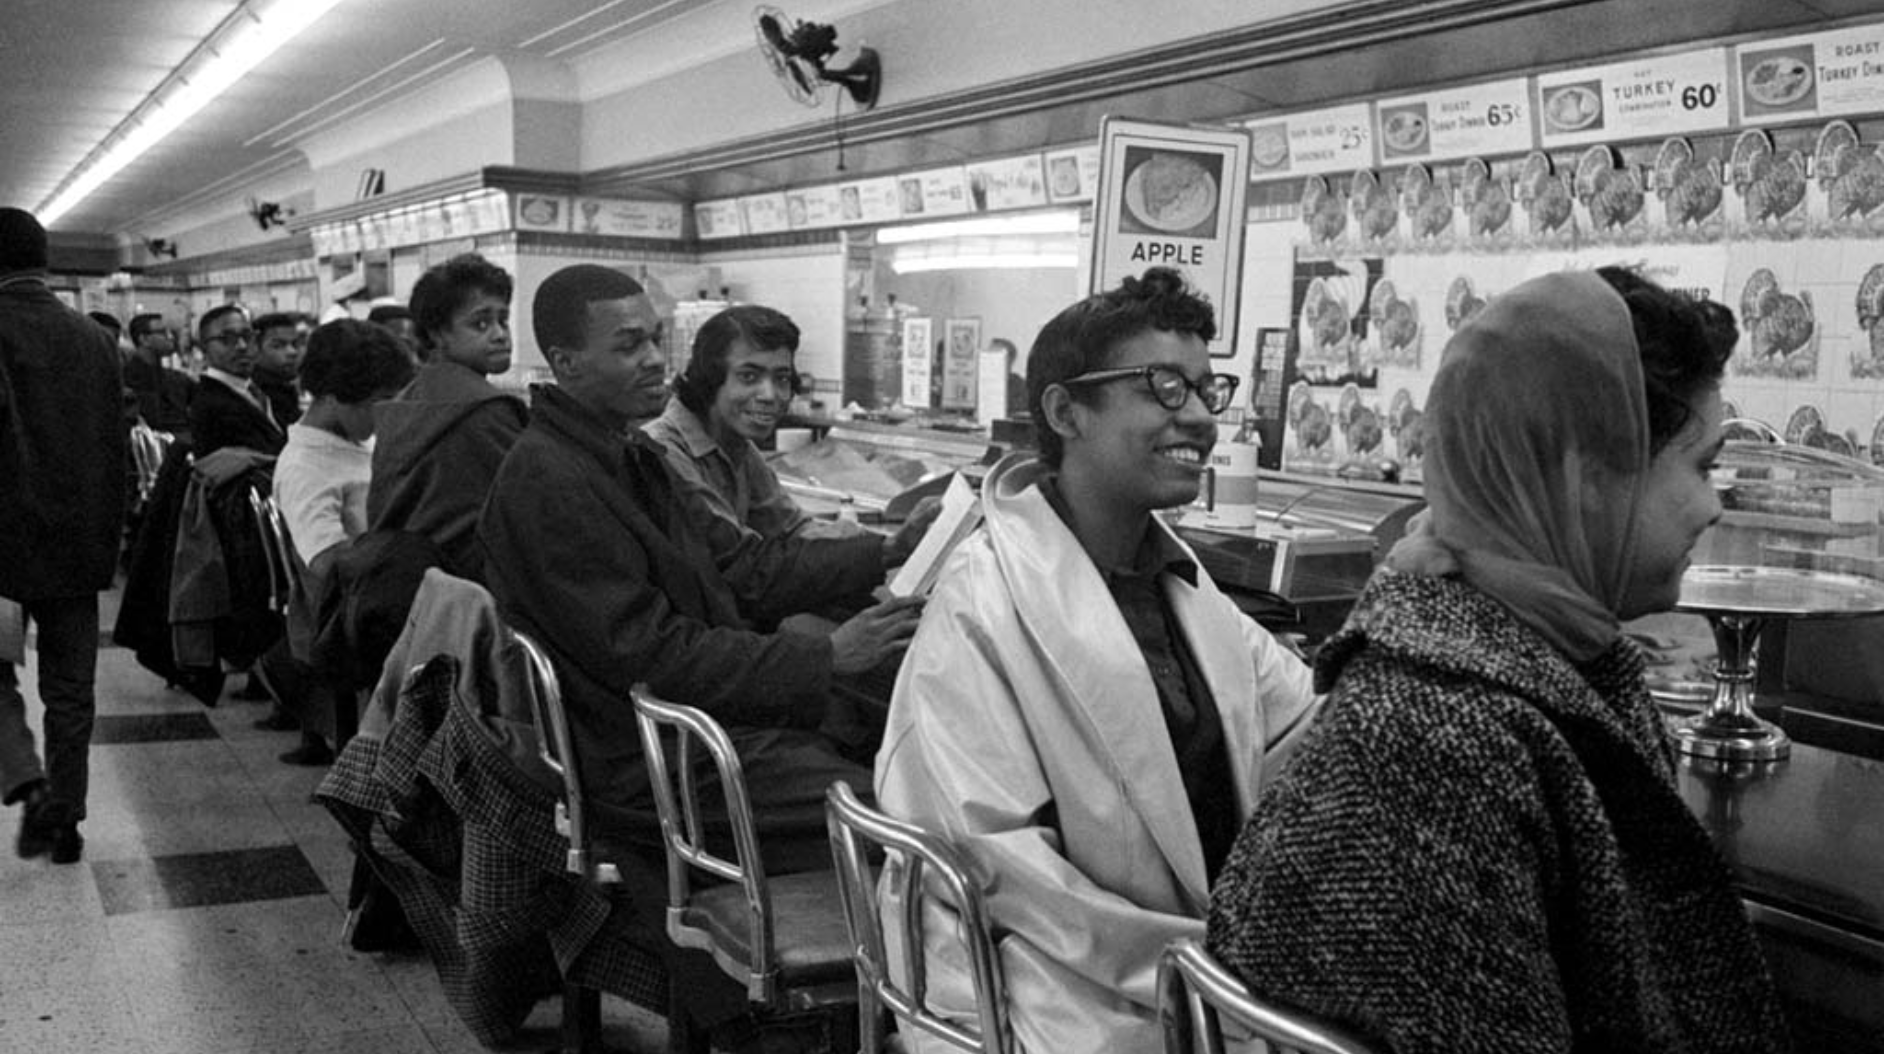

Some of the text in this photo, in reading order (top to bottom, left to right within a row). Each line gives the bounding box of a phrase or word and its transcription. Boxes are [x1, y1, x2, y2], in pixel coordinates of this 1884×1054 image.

[1835, 41, 1880, 57] ROAST
[1612, 79, 1675, 100] TURKEY
[1131, 241, 1204, 265] APPLE
